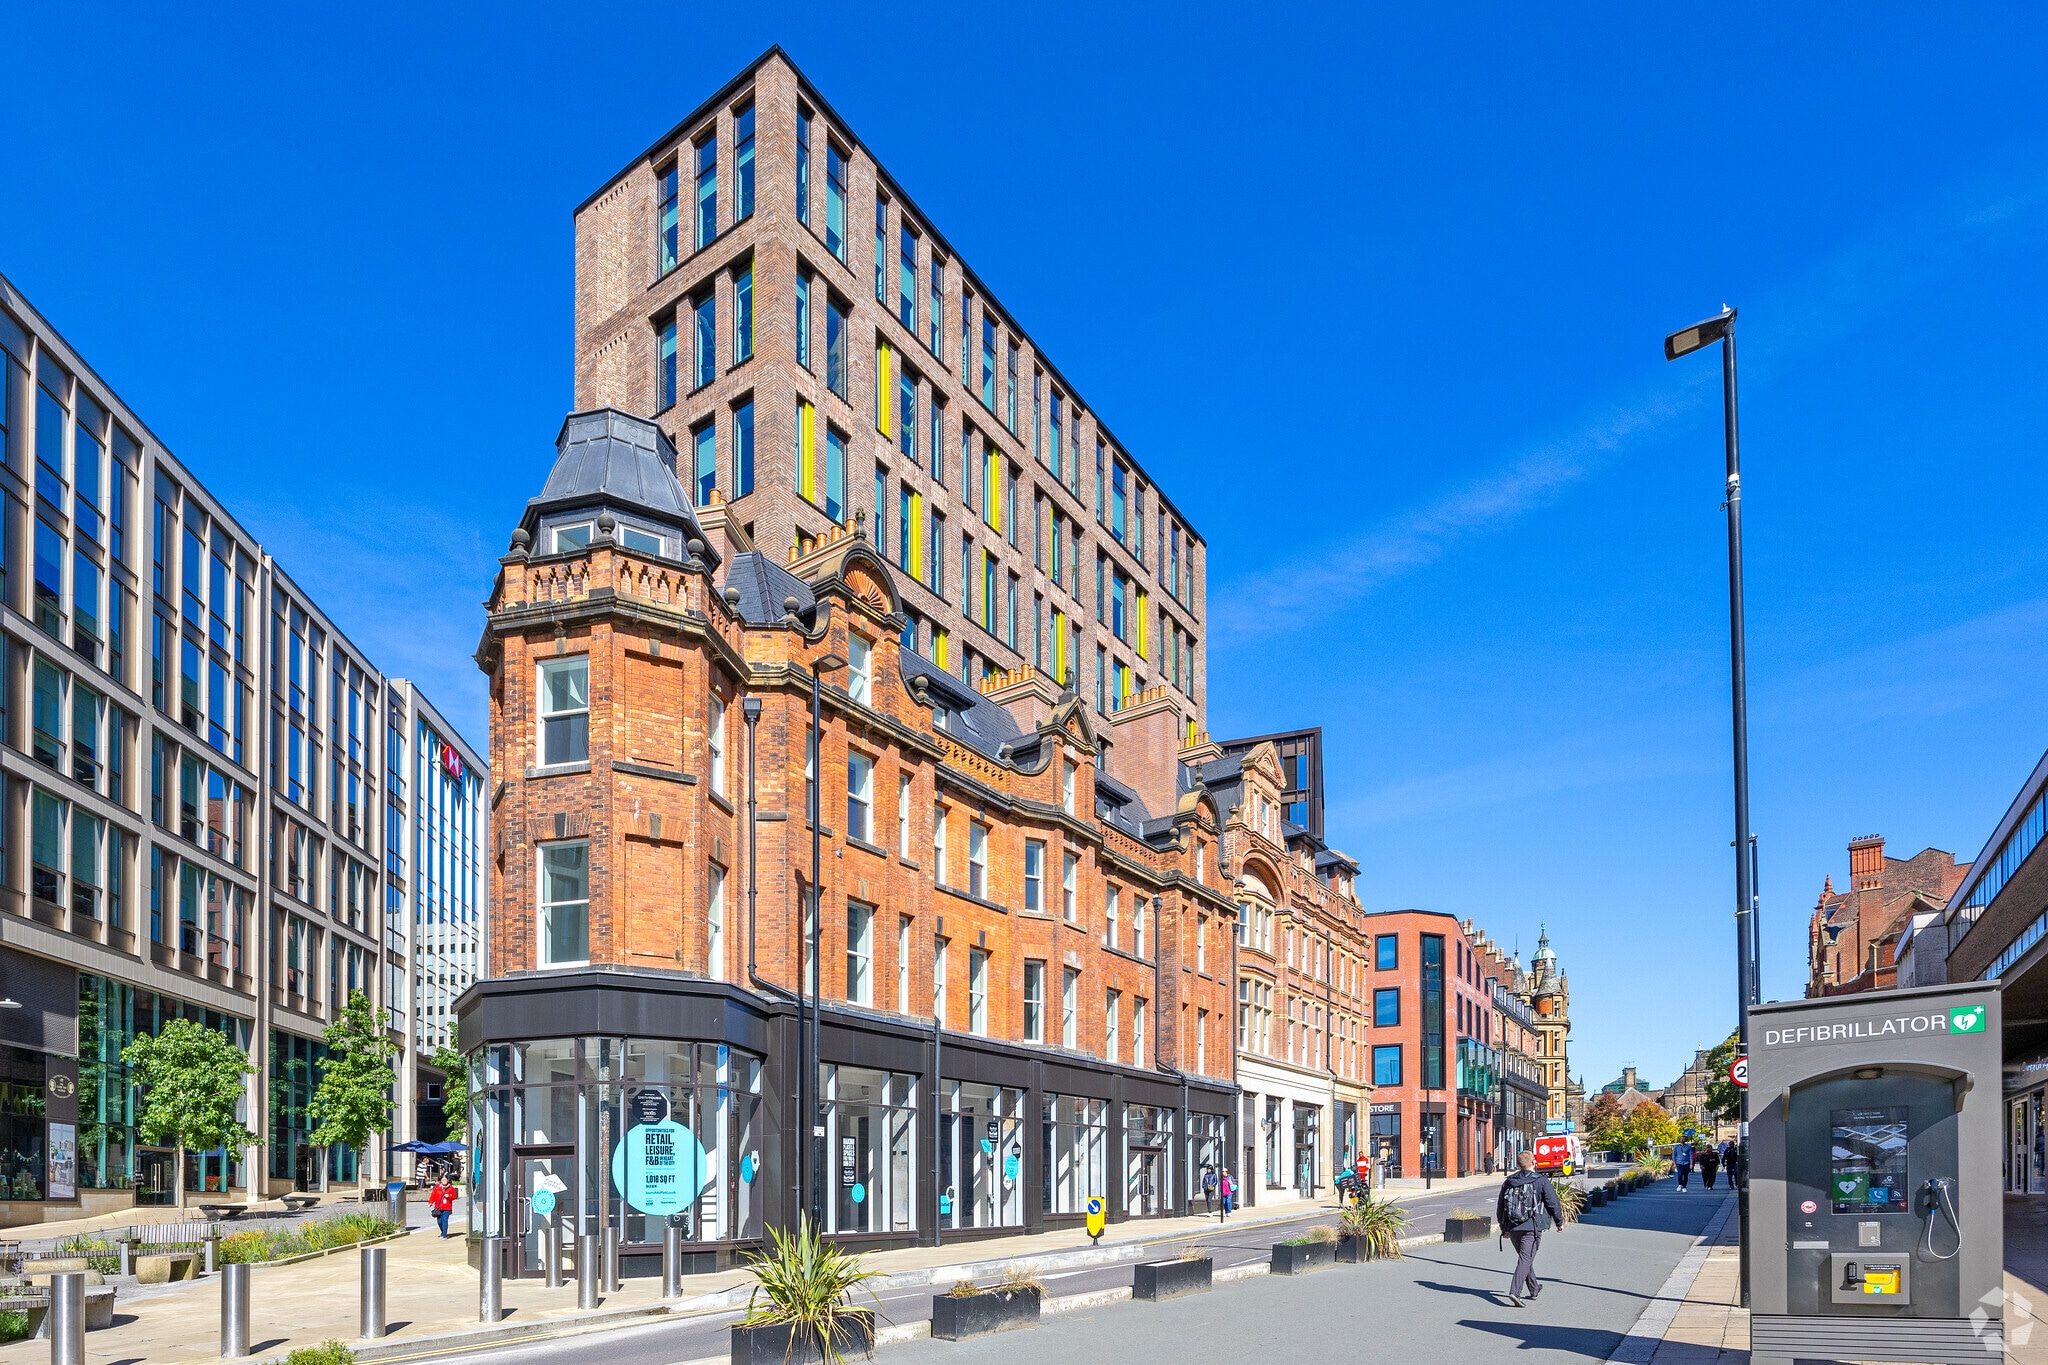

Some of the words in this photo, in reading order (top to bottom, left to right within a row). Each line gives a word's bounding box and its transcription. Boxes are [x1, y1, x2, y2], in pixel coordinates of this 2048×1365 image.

[1766, 1014, 1947, 1045] DEFIBRILLATOR
[1369, 1104, 1395, 1113] STORE
[645, 1133, 675, 1146] RETAIL,
[645, 1146, 675, 1156] LEISURE,
[1551, 1145, 1565, 1153] dpd
[645, 1156, 659, 1165] F&B
[660, 1175, 668, 1184] SQ
[668, 1175, 675, 1183] FT
